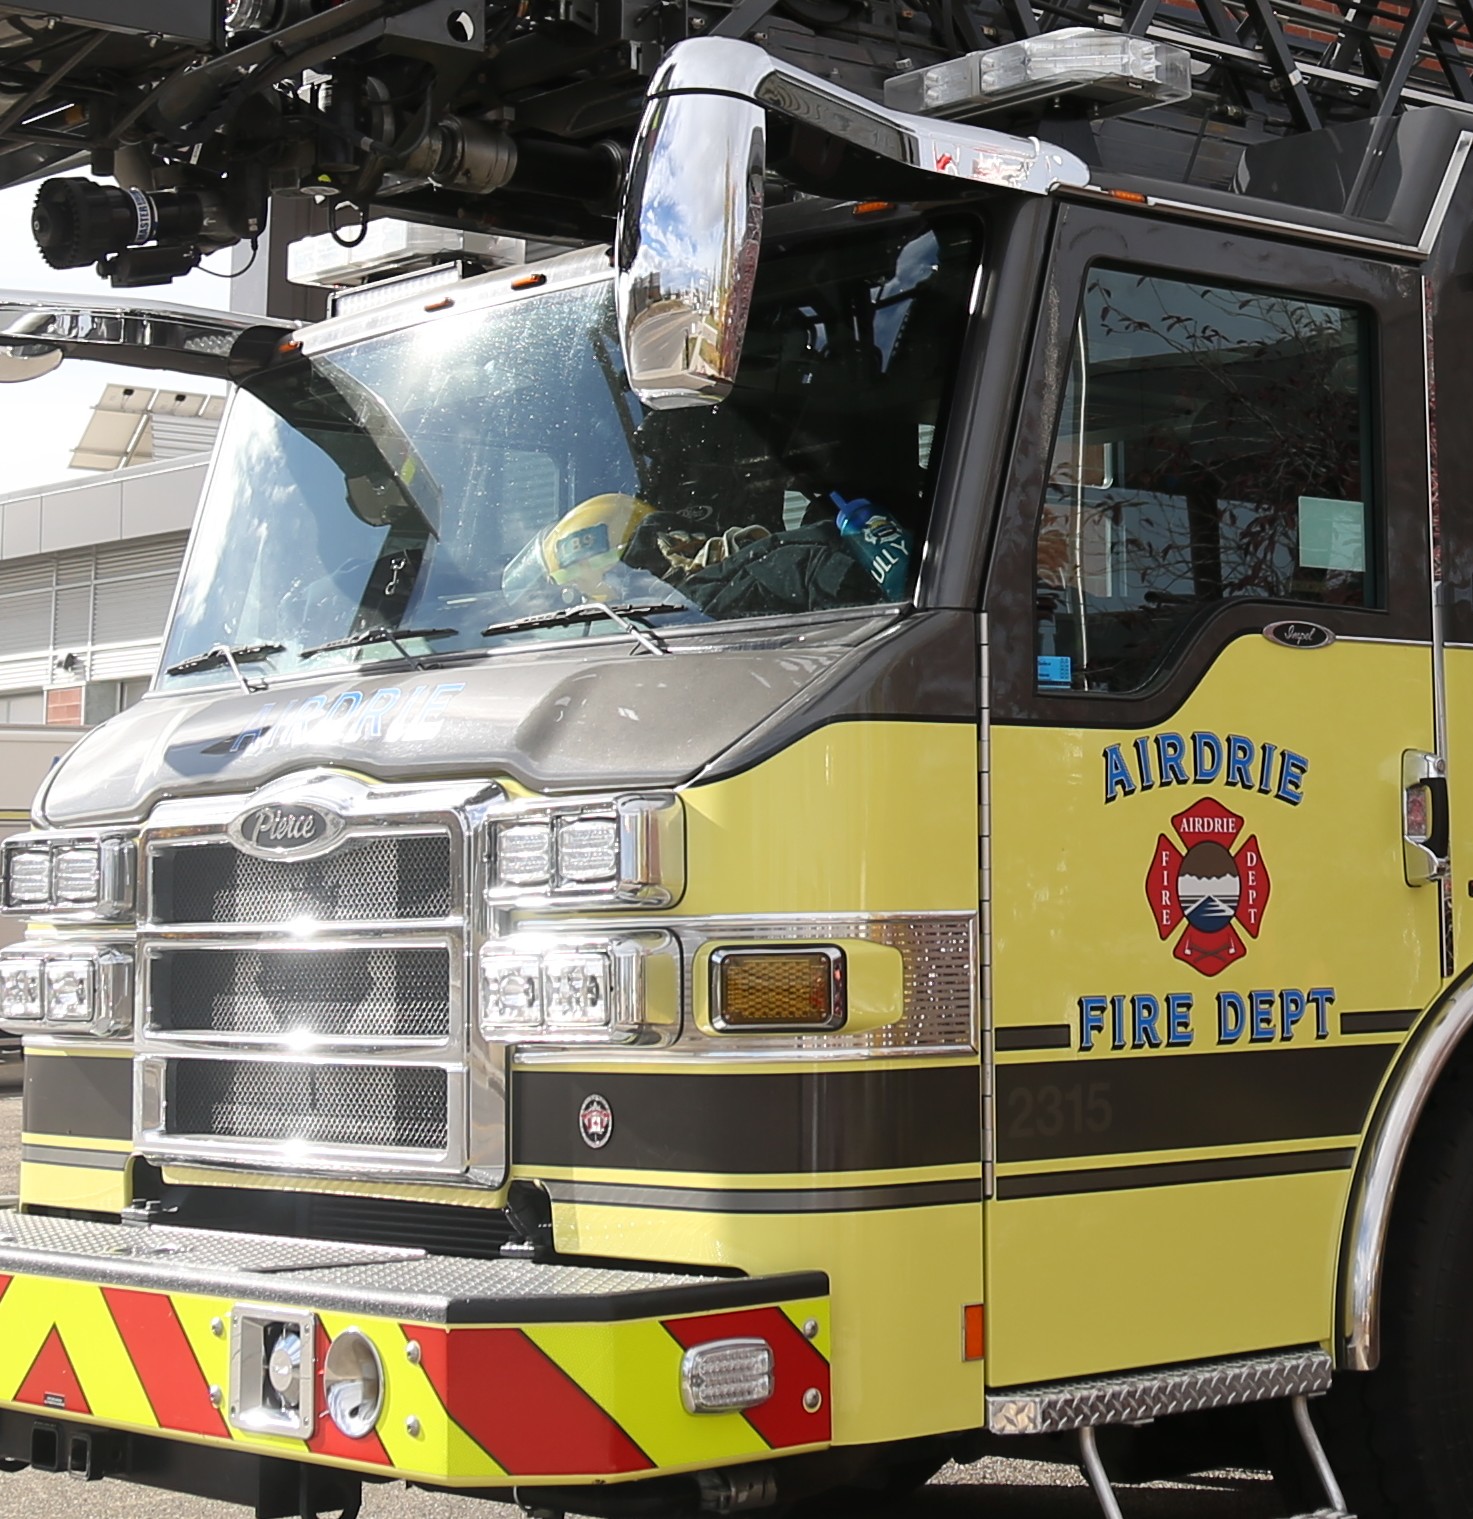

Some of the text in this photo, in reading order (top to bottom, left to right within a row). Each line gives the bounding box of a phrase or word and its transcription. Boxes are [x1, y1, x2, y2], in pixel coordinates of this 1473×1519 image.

[1102, 731, 1309, 806] AIRDRIE
[251, 807, 316, 847] Pierce
[1180, 817, 1236, 833] AIRDRIE
[1161, 851, 1171, 925] FIRE
[1246, 851, 1257, 924] DEPT
[1078, 987, 1336, 1052] FIRE DEPT
[1007, 1081, 1113, 1139] 2315
